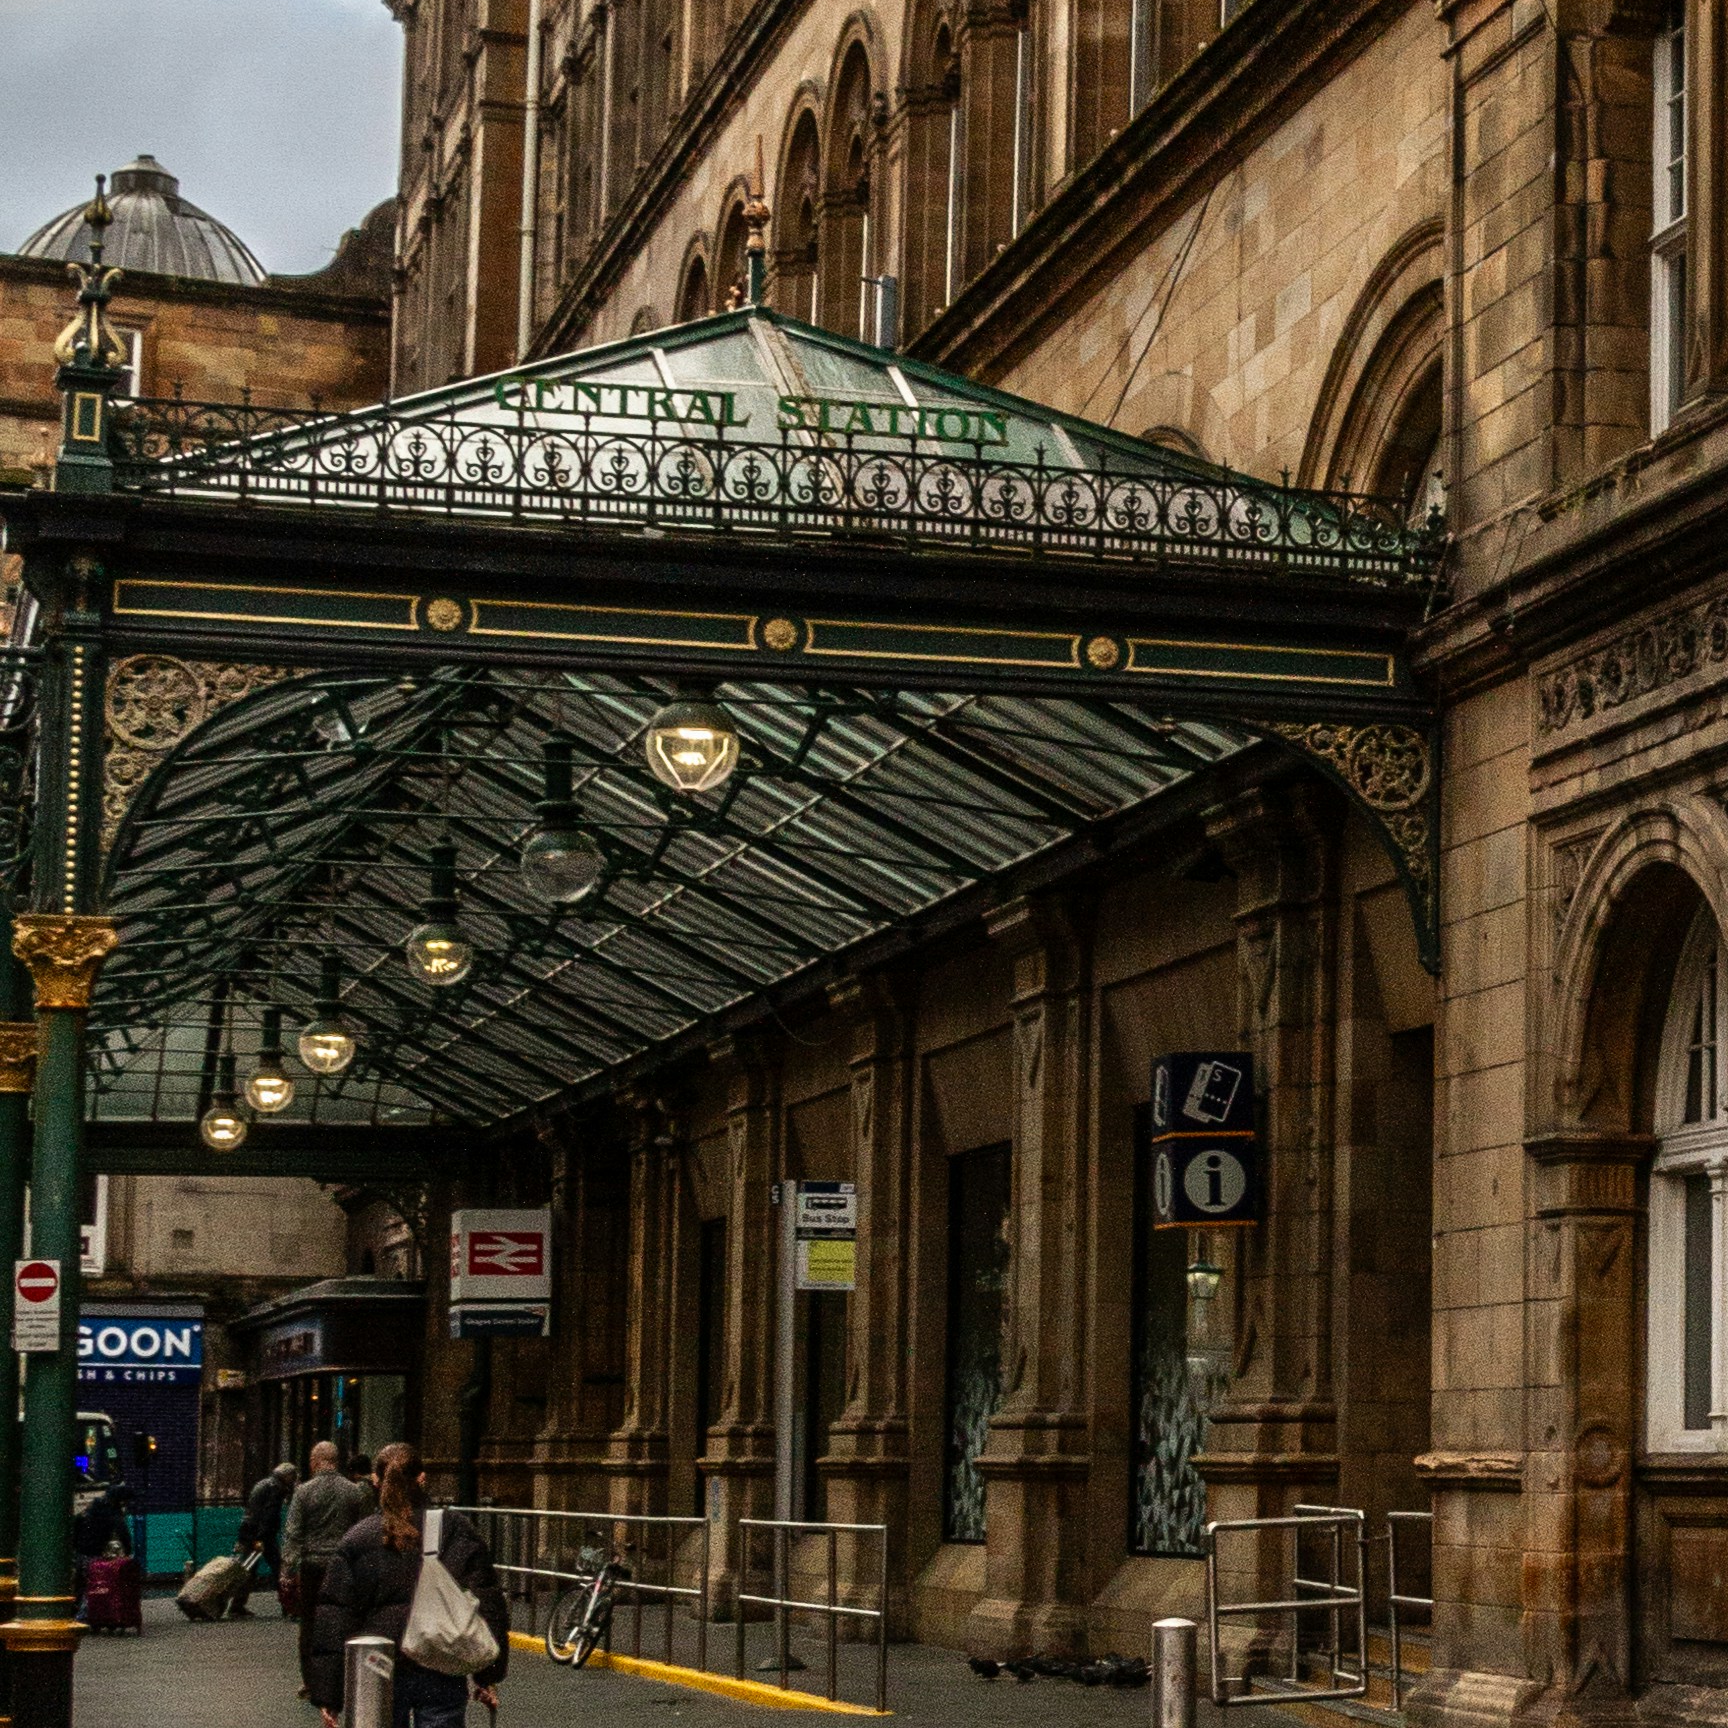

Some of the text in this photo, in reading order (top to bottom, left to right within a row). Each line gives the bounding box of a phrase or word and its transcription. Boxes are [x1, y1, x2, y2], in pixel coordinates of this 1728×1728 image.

[494, 376, 1010, 446] CENTRAL STATION
[123, 1369, 177, 1381] CHIPS
